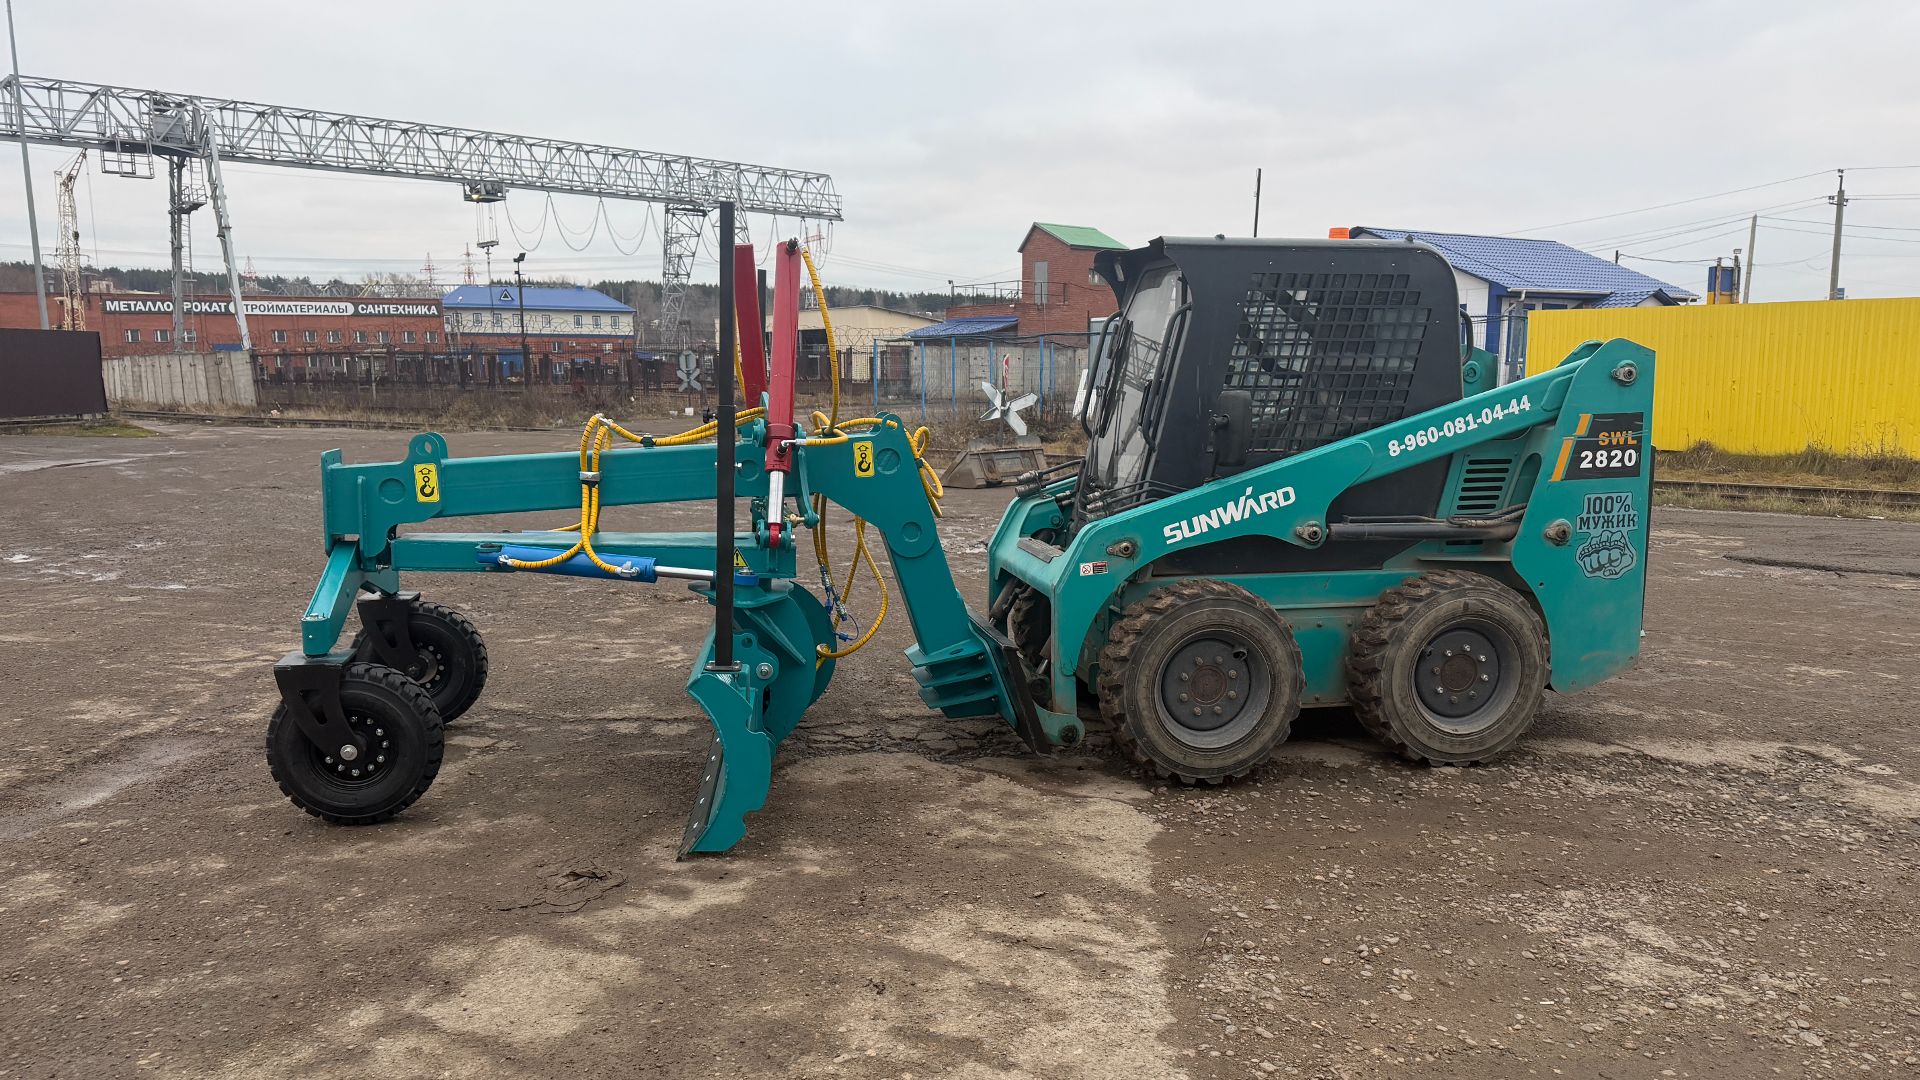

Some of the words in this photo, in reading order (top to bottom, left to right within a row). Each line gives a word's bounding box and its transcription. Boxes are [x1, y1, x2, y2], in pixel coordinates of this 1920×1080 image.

[105, 300, 227, 313] МЕТАЛЛОРОКАТ
[241, 301, 348, 314] ТРОЙМАТЕРИАЛЫ
[358, 303, 438, 315] САНТЕХНИКА
[1388, 395, 1531, 457] 8-960-081-04-44
[1598, 430, 1637, 446] SWL
[1579, 449, 1637, 469] 2820
[1586, 494, 1631, 515] 100%
[1163, 486, 1296, 545] SUNWARD
[1578, 513, 1637, 531] МУЖИК
